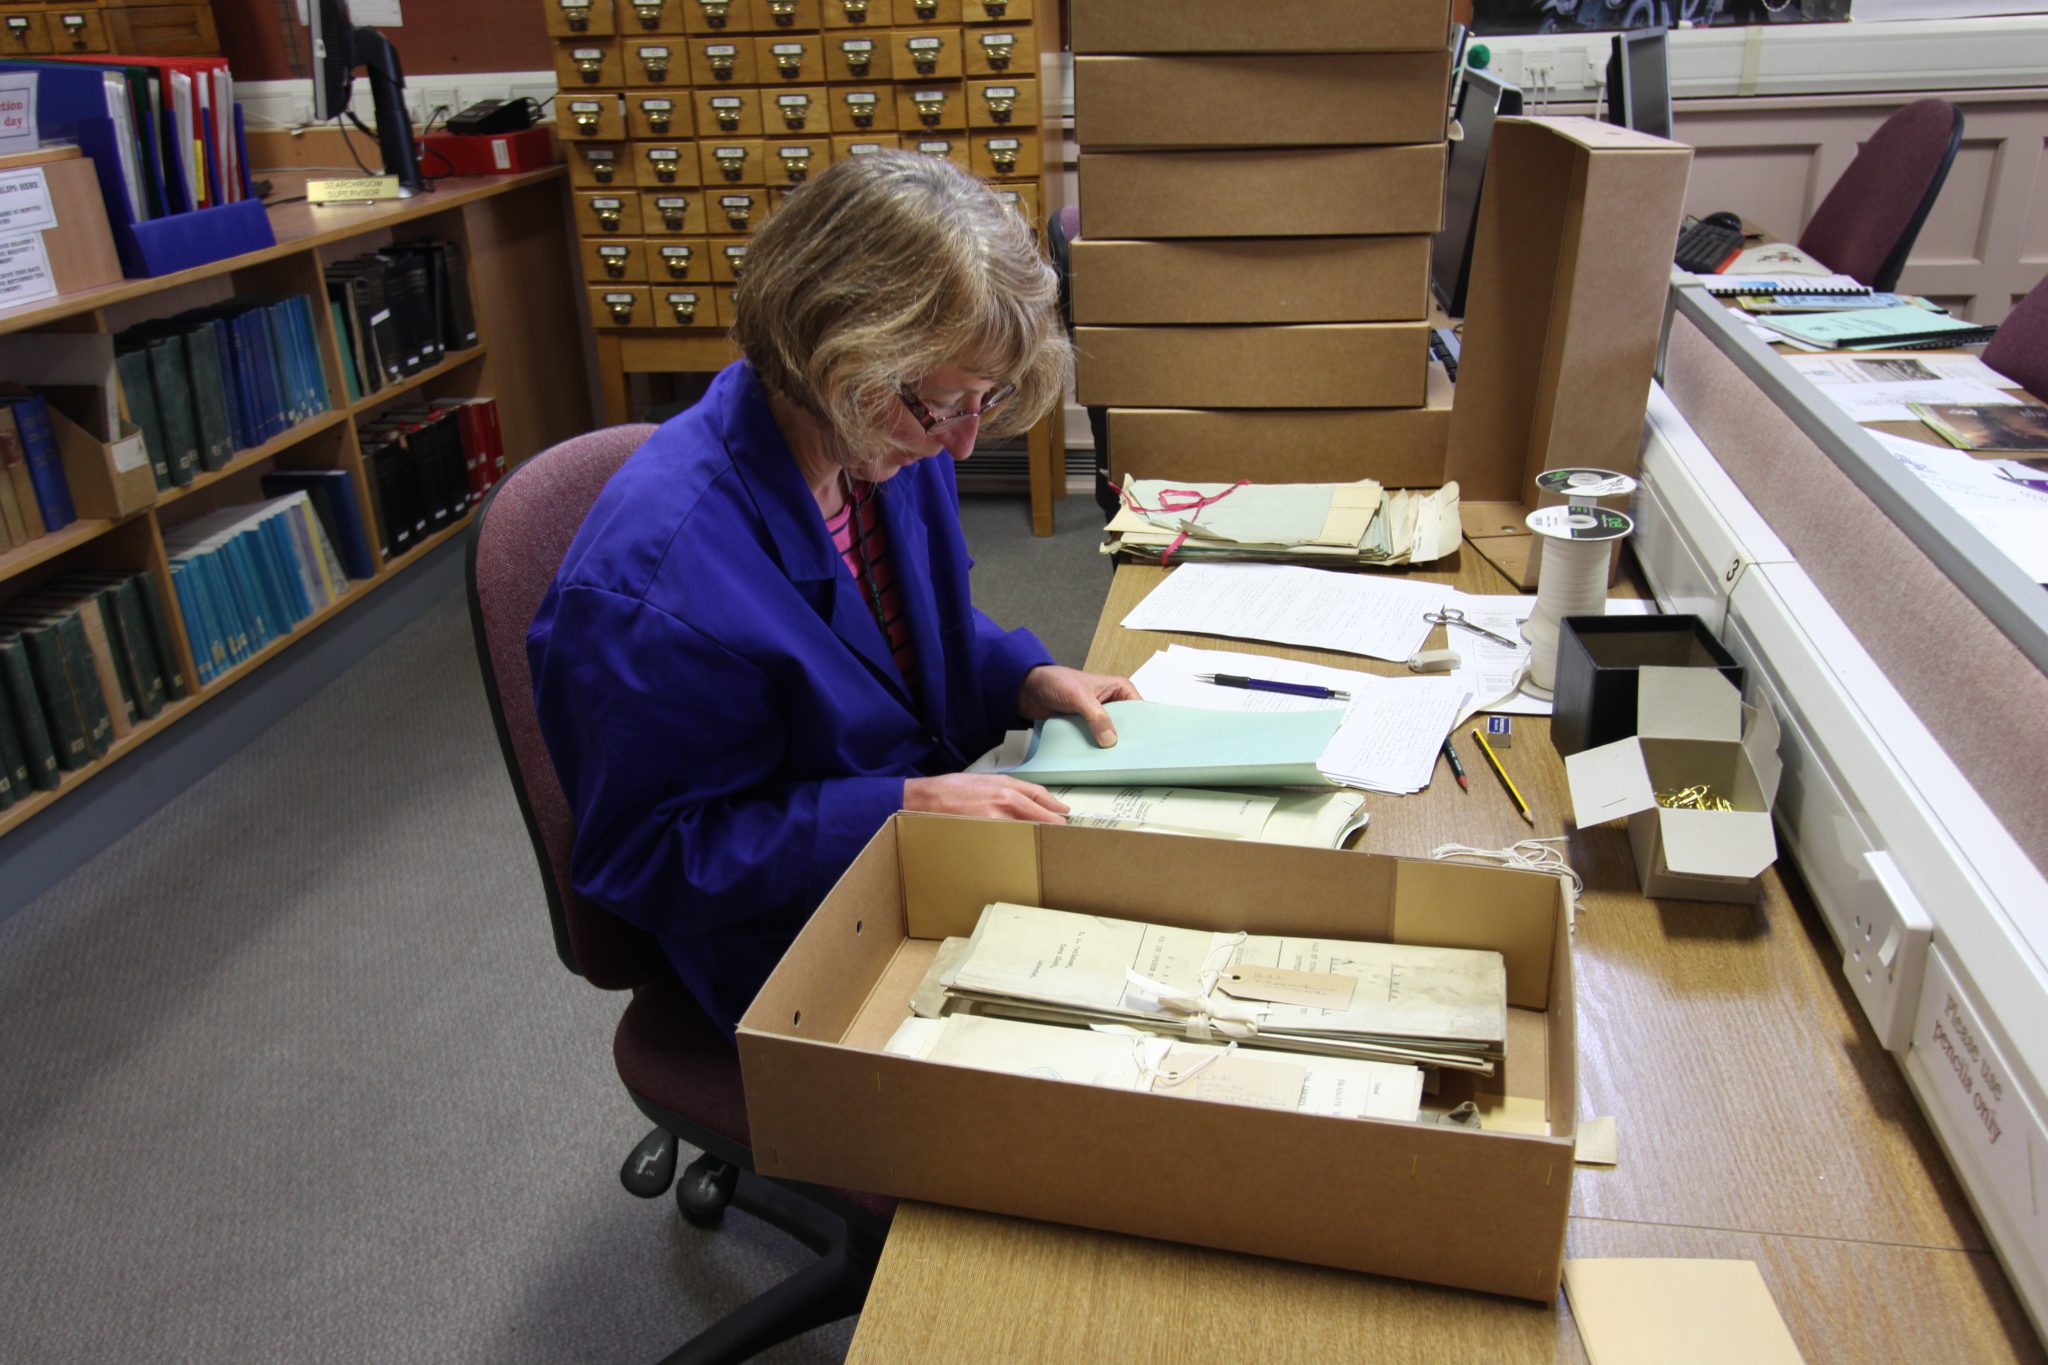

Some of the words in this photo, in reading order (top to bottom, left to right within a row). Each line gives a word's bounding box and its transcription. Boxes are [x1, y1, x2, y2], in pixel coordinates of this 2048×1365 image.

[0, 101, 23, 111] tion
[4, 117, 24, 129] day
[19, 181, 40, 191] HERE
[324, 181, 383, 189] SEARCHROOM
[328, 189, 381, 198] SUPERVISOR
[1726, 558, 1740, 582] 3
[1945, 993, 1980, 1064] Please
[1980, 1057, 2004, 1102] use
[1933, 1019, 1974, 1092] pencils
[1973, 1091, 2003, 1145] only
